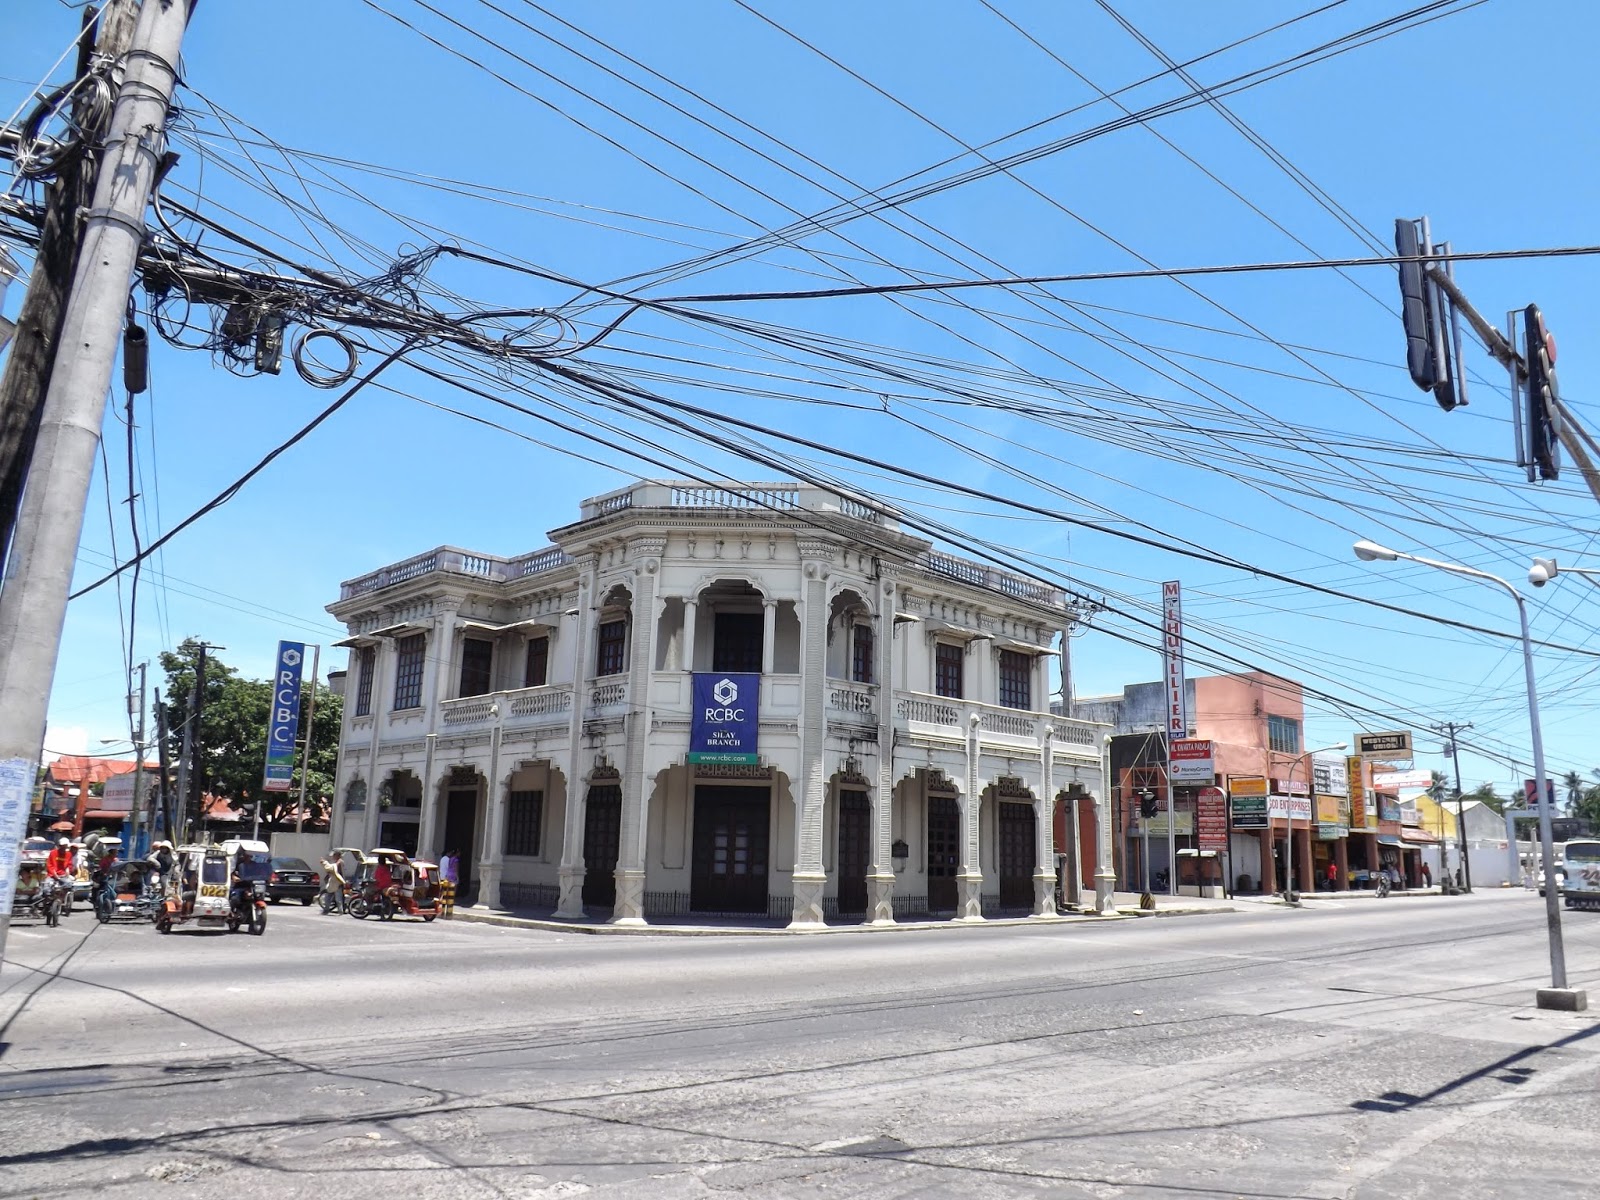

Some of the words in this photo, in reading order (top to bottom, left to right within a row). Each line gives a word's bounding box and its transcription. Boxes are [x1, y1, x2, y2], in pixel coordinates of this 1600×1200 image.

[274, 670, 294, 742] RCBC
[705, 708, 745, 722] RCBC
[712, 731, 736, 739] SILAY
[700, 754, 747, 762] www.rcbc.com
[1280, 780, 1301, 790] MOTLITE
[1352, 770, 1365, 825] PALAWAN
[1280, 799, 1310, 811] ENTRPRISES
